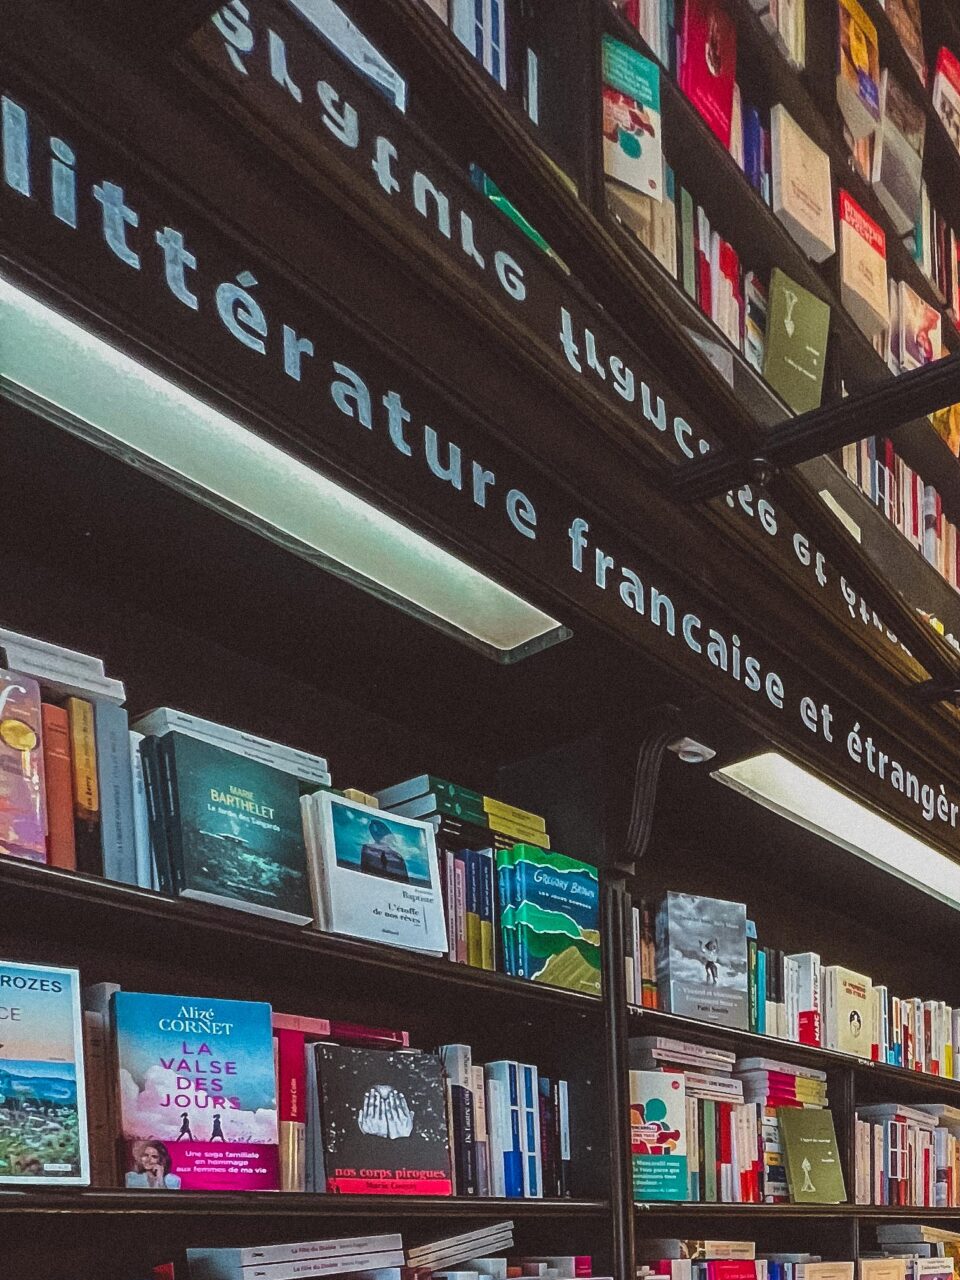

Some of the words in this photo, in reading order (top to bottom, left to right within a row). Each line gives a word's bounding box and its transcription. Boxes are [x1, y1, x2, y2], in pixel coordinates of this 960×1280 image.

[1, 95, 538, 540] littérature
[568, 517, 785, 709] francaise
[799, 696, 833, 743] et
[210, 788, 275, 820] BARTHELET
[177, 1006, 215, 1021] Alizé
[159, 1019, 234, 1036] CORNET
[182, 1041, 213, 1056] LA
[159, 1058, 238, 1075] VALSE
[176, 1076, 224, 1092] DES
[160, 1095, 241, 1111] JOURS
[228, 1165, 239, 1173] de
[334, 1168, 356, 1177] nos
[359, 1168, 392, 1178] corps
[395, 1168, 446, 1179] pirogues
